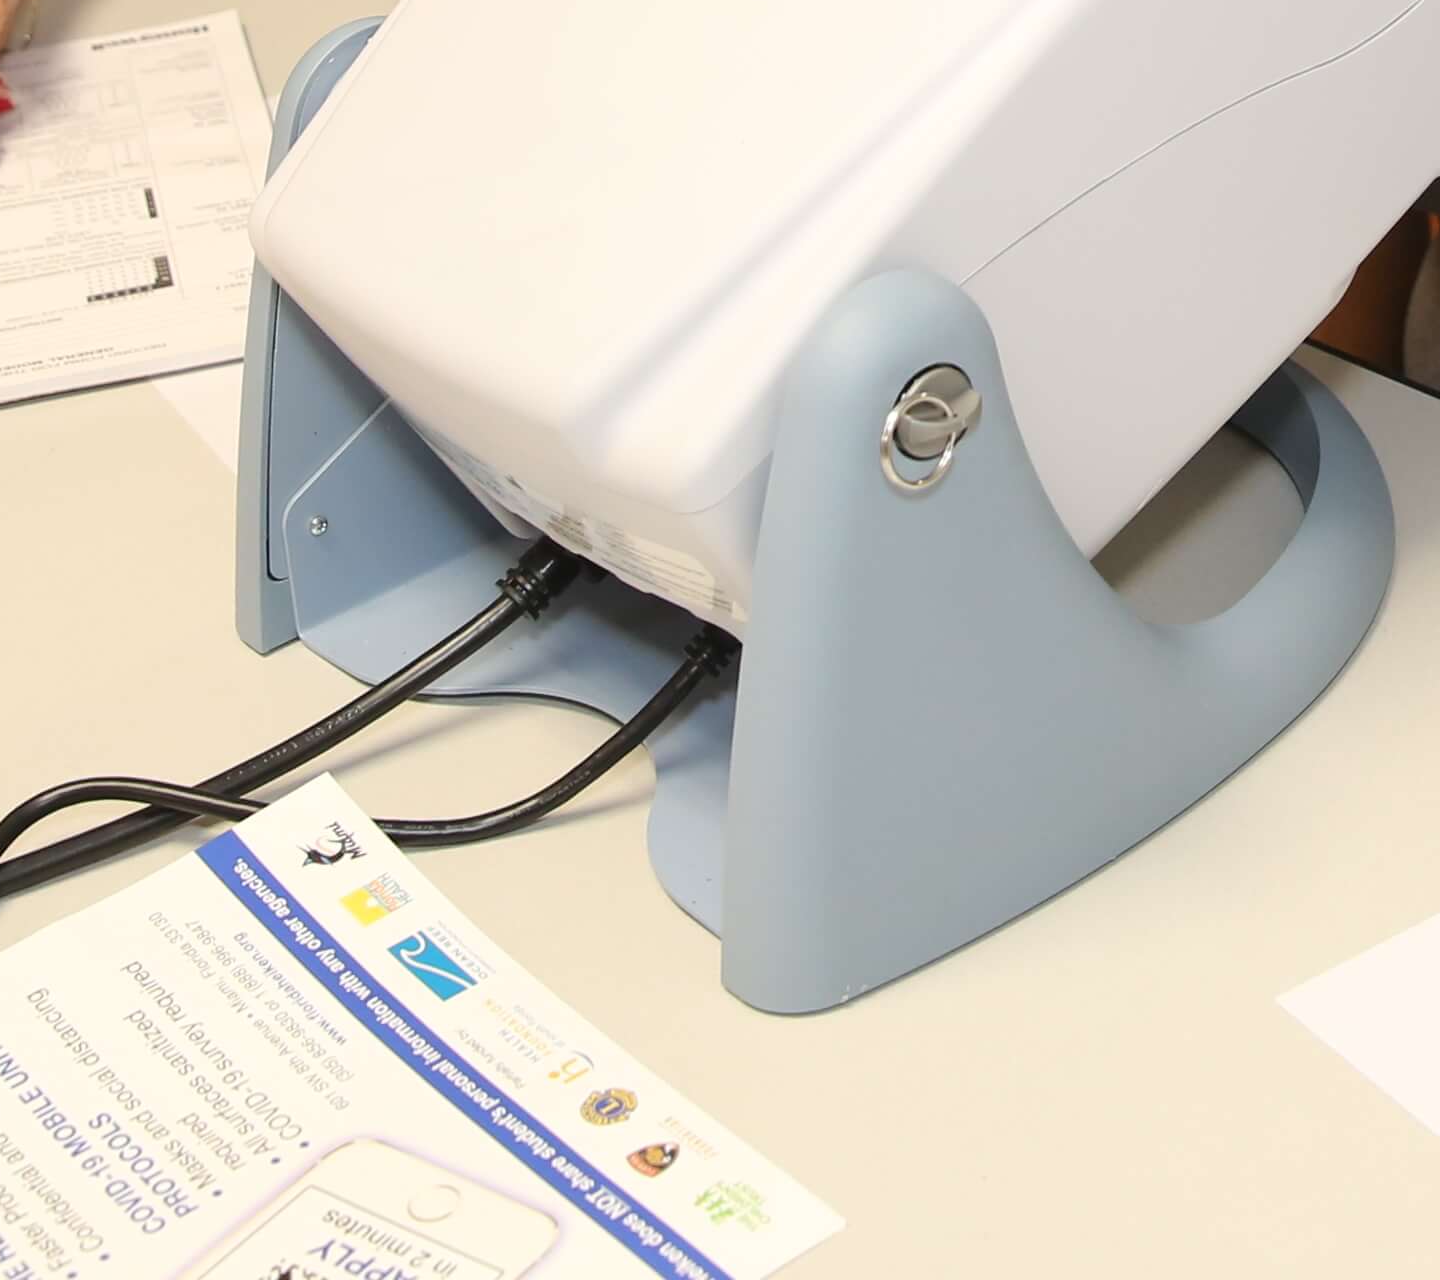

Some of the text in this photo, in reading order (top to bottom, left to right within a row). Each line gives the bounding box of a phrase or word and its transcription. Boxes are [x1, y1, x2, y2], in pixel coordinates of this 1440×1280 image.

[234, 859, 290, 917] agencies.
[373, 870, 419, 906] HEALTH
[284, 917, 321, 950] other
[424, 924, 455, 949] REEF
[316, 949, 345, 973] any
[339, 971, 370, 1000] with
[450, 946, 492, 982] OCEAN
[148, 911, 350, 1111] 601 SW 8th Avenue Miami, Florida 33130
[185, 921, 355, 1083] (305) 856-9830 or 1 (888) 996-9847
[234, 932, 346, 1045] www.floridaheiken.org
[120, 961, 302, 1140] COVID-19 survey required
[367, 997, 440, 1064] information
[27, 988, 216, 1190] Masks and social distancing
[124, 1010, 275, 1156] All surfaces sanitized
[432, 1060, 499, 1110] personal
[19, 1087, 90, 1157] MOBILE
[177, 1113, 245, 1171] required
[492, 1107, 555, 1159] student's
[89, 1113, 197, 1217] PROTOCOLS
[552, 1156, 594, 1191] share
[14, 1164, 103, 1252] Confidential
[82, 1155, 166, 1234] COVID-19
[586, 1187, 629, 1219] NOT
[21, 1222, 72, 1272] Faster
[322, 1208, 412, 1258] minutes
[623, 1214, 663, 1246] does
[409, 1250, 432, 1268] 2
